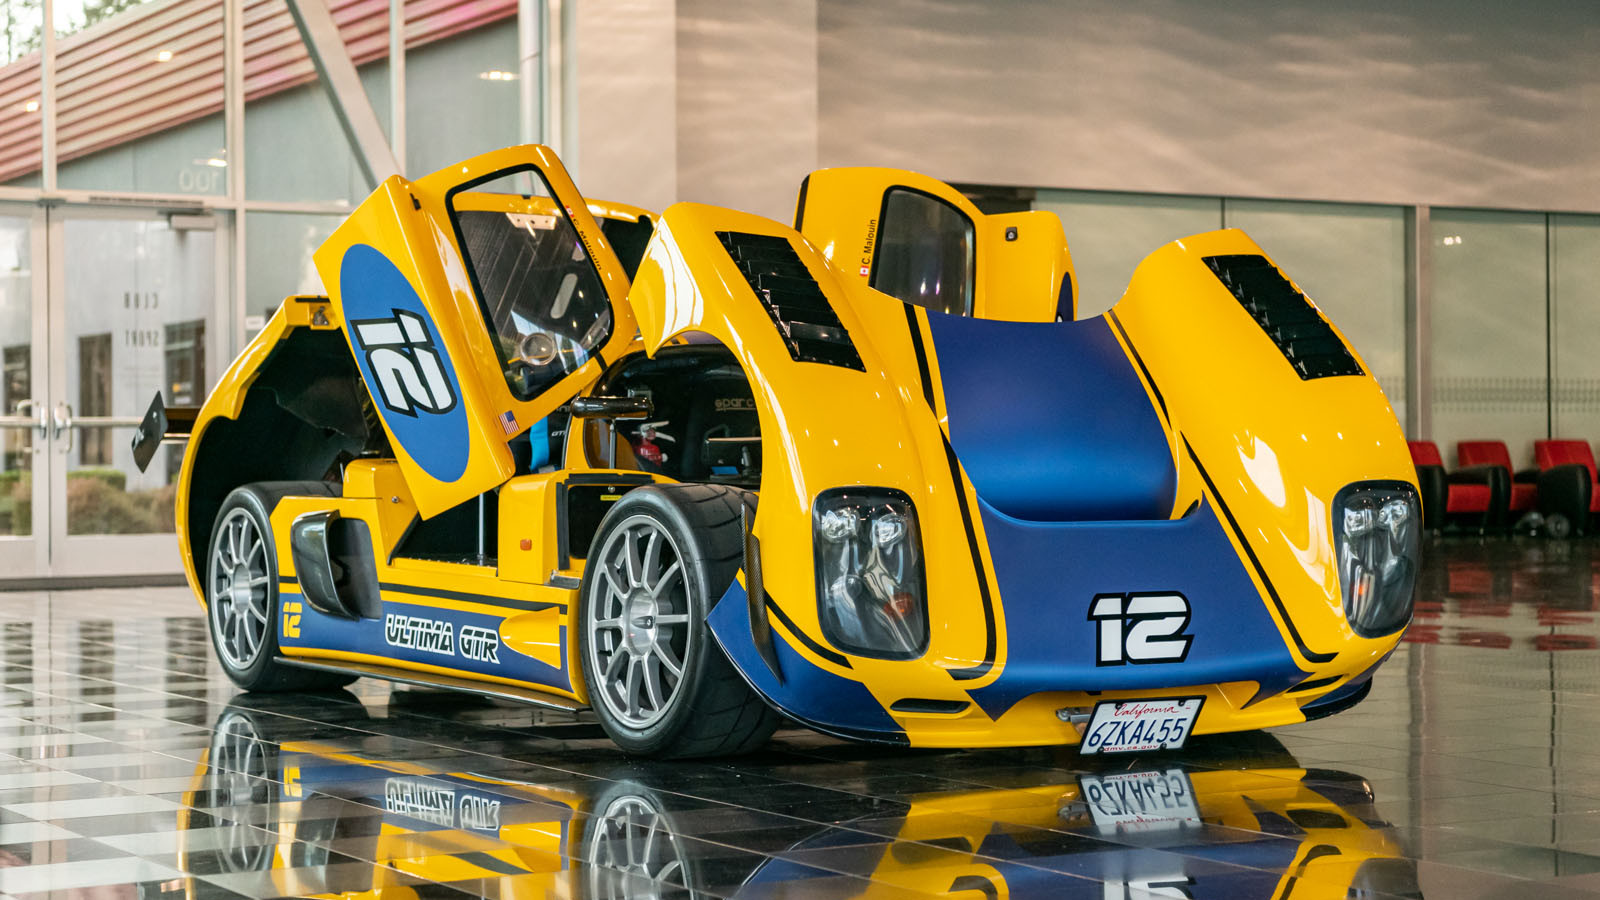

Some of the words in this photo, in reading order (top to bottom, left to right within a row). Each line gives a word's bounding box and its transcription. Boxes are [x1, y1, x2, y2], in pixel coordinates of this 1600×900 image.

[864, 219, 877, 254] Malouin
[861, 257, 871, 265] C.
[350, 307, 457, 418] 12
[715, 398, 756, 412] sparc
[282, 602, 302, 638] 12
[1087, 590, 1194, 667] 12
[384, 613, 455, 656] ULTIMA
[459, 624, 500, 664] GTR
[1114, 703, 1180, 719] California
[1088, 718, 1188, 747] 6ZKA455
[1104, 744, 1158, 752] dmv.ca.gov
